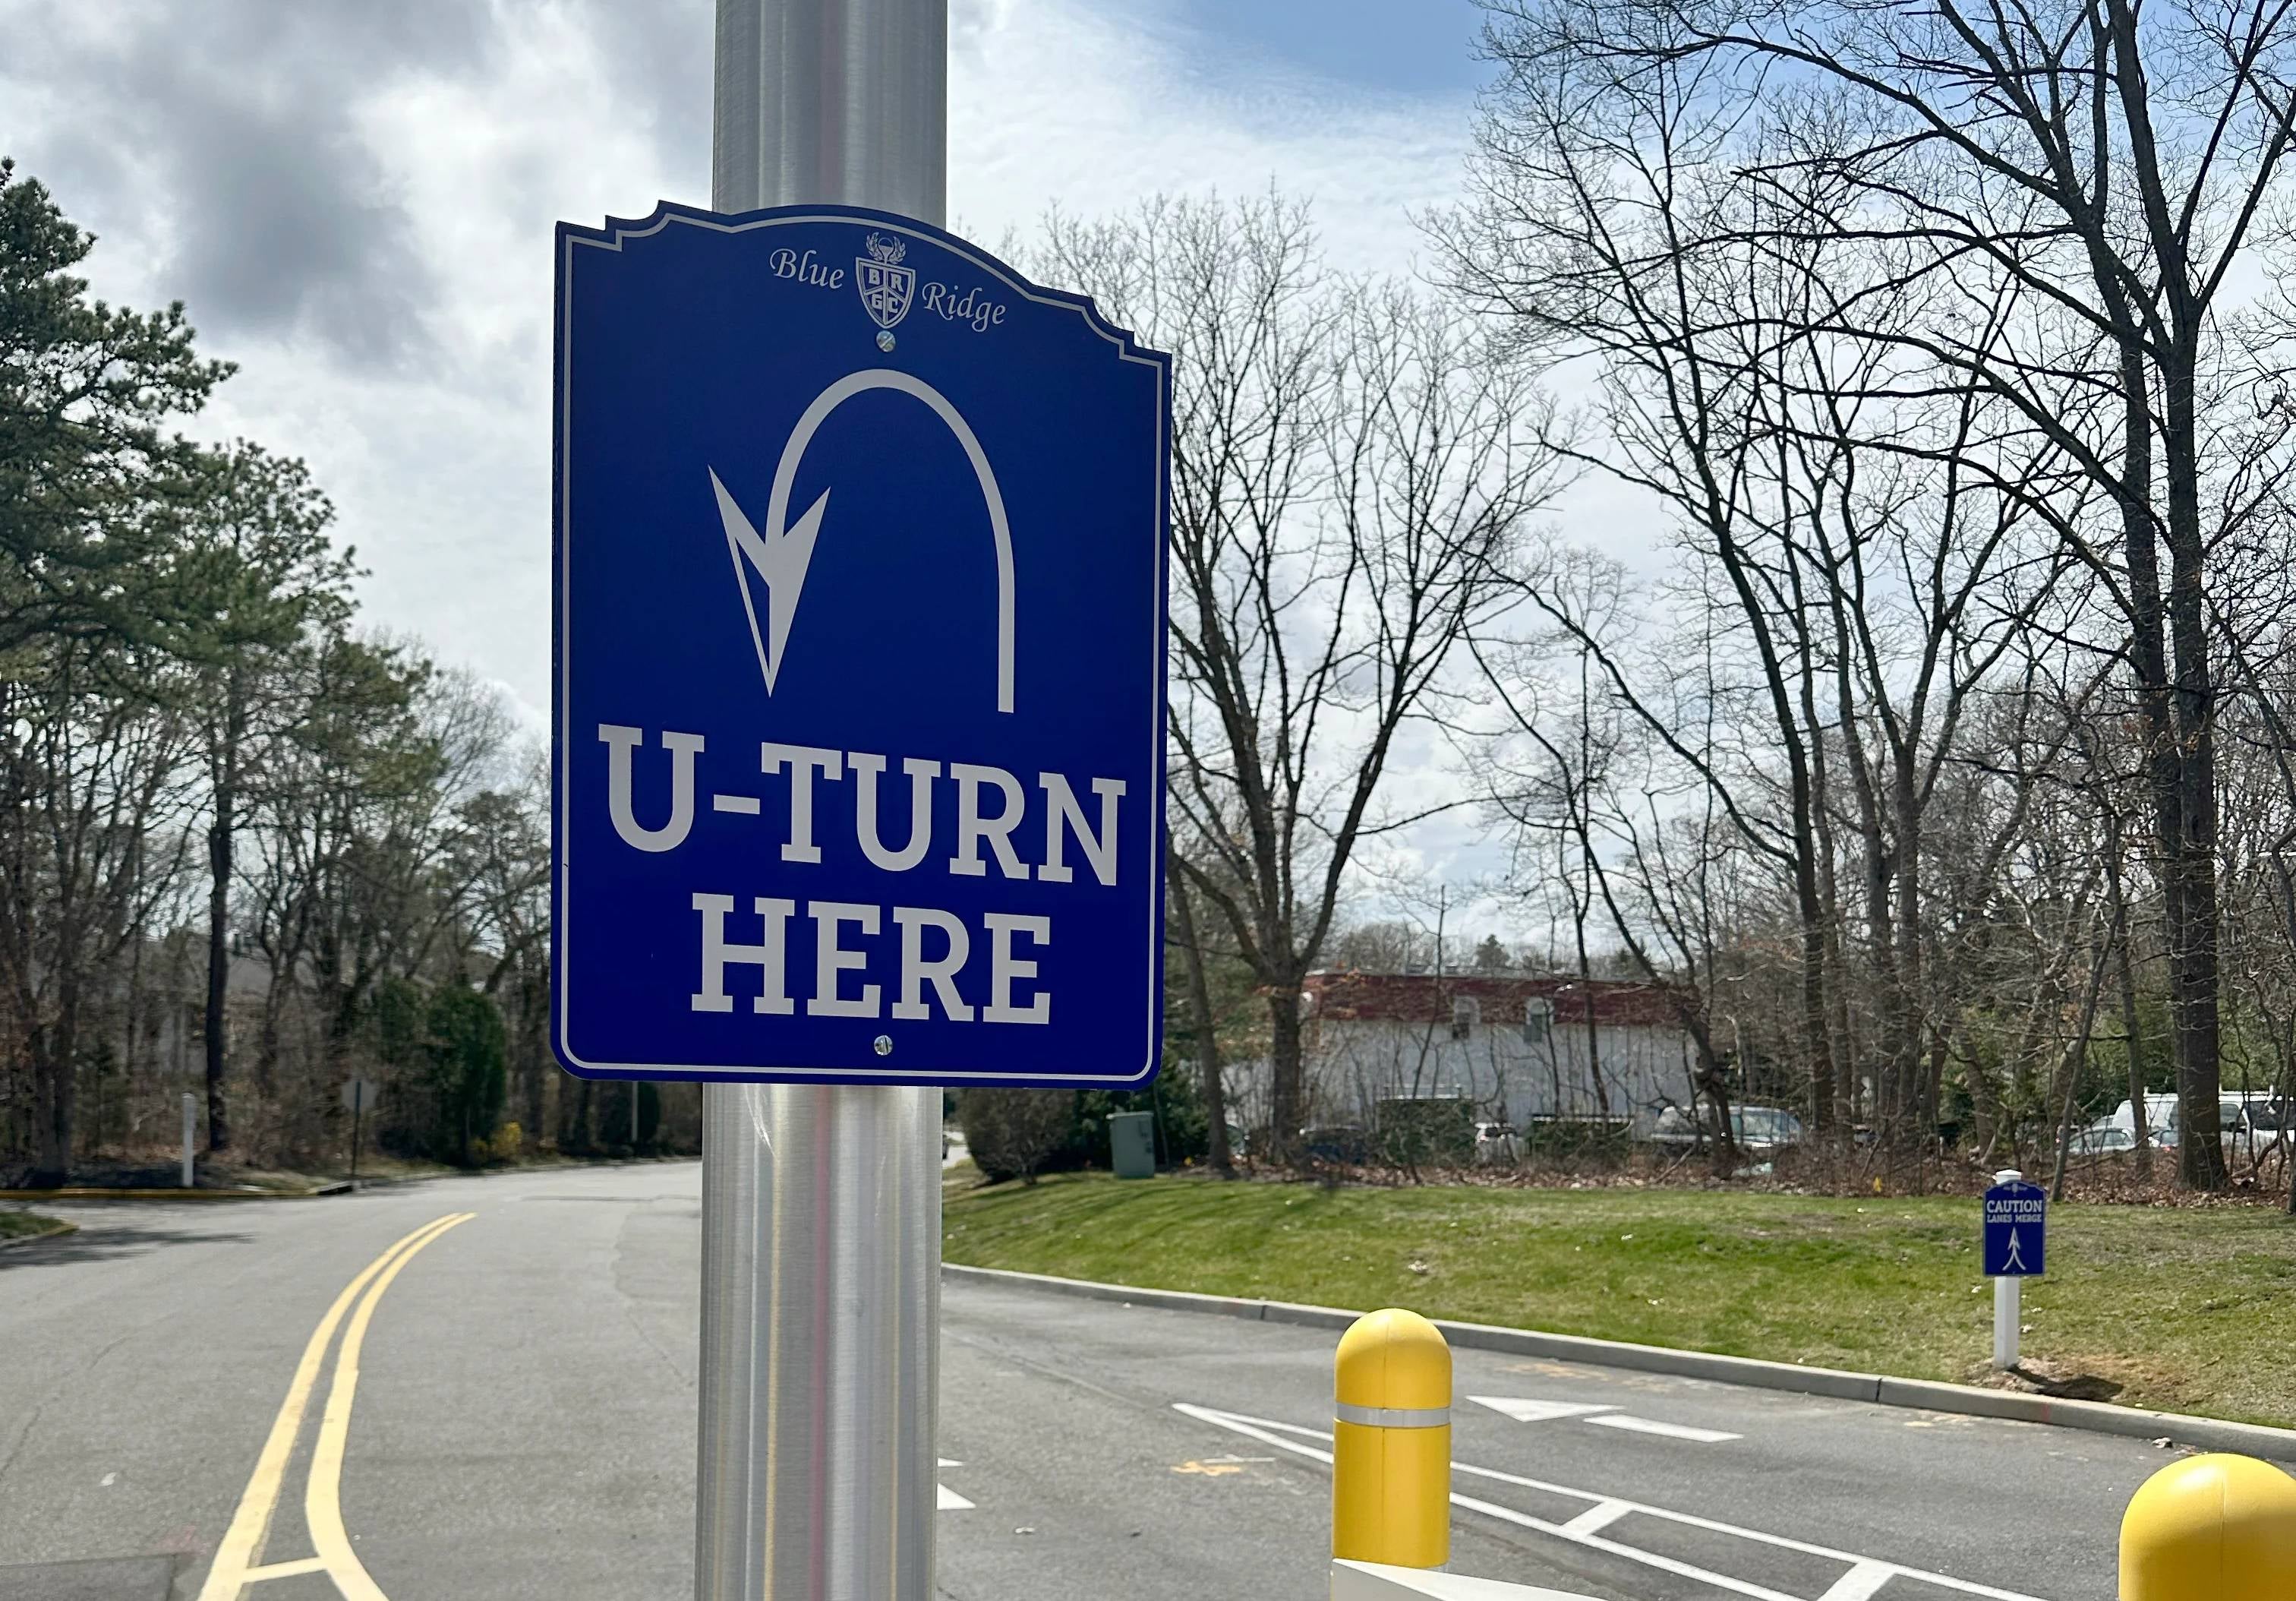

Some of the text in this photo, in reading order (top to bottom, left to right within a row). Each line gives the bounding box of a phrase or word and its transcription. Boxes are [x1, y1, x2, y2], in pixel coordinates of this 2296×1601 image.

[769, 248, 1007, 333] Blue Ridge
[598, 723, 1128, 886] U-TURN
[691, 892, 1051, 1025] HERE
[1986, 1200, 2042, 1213] CAUTION
[1987, 1214, 2042, 1224] LANES MERGE
